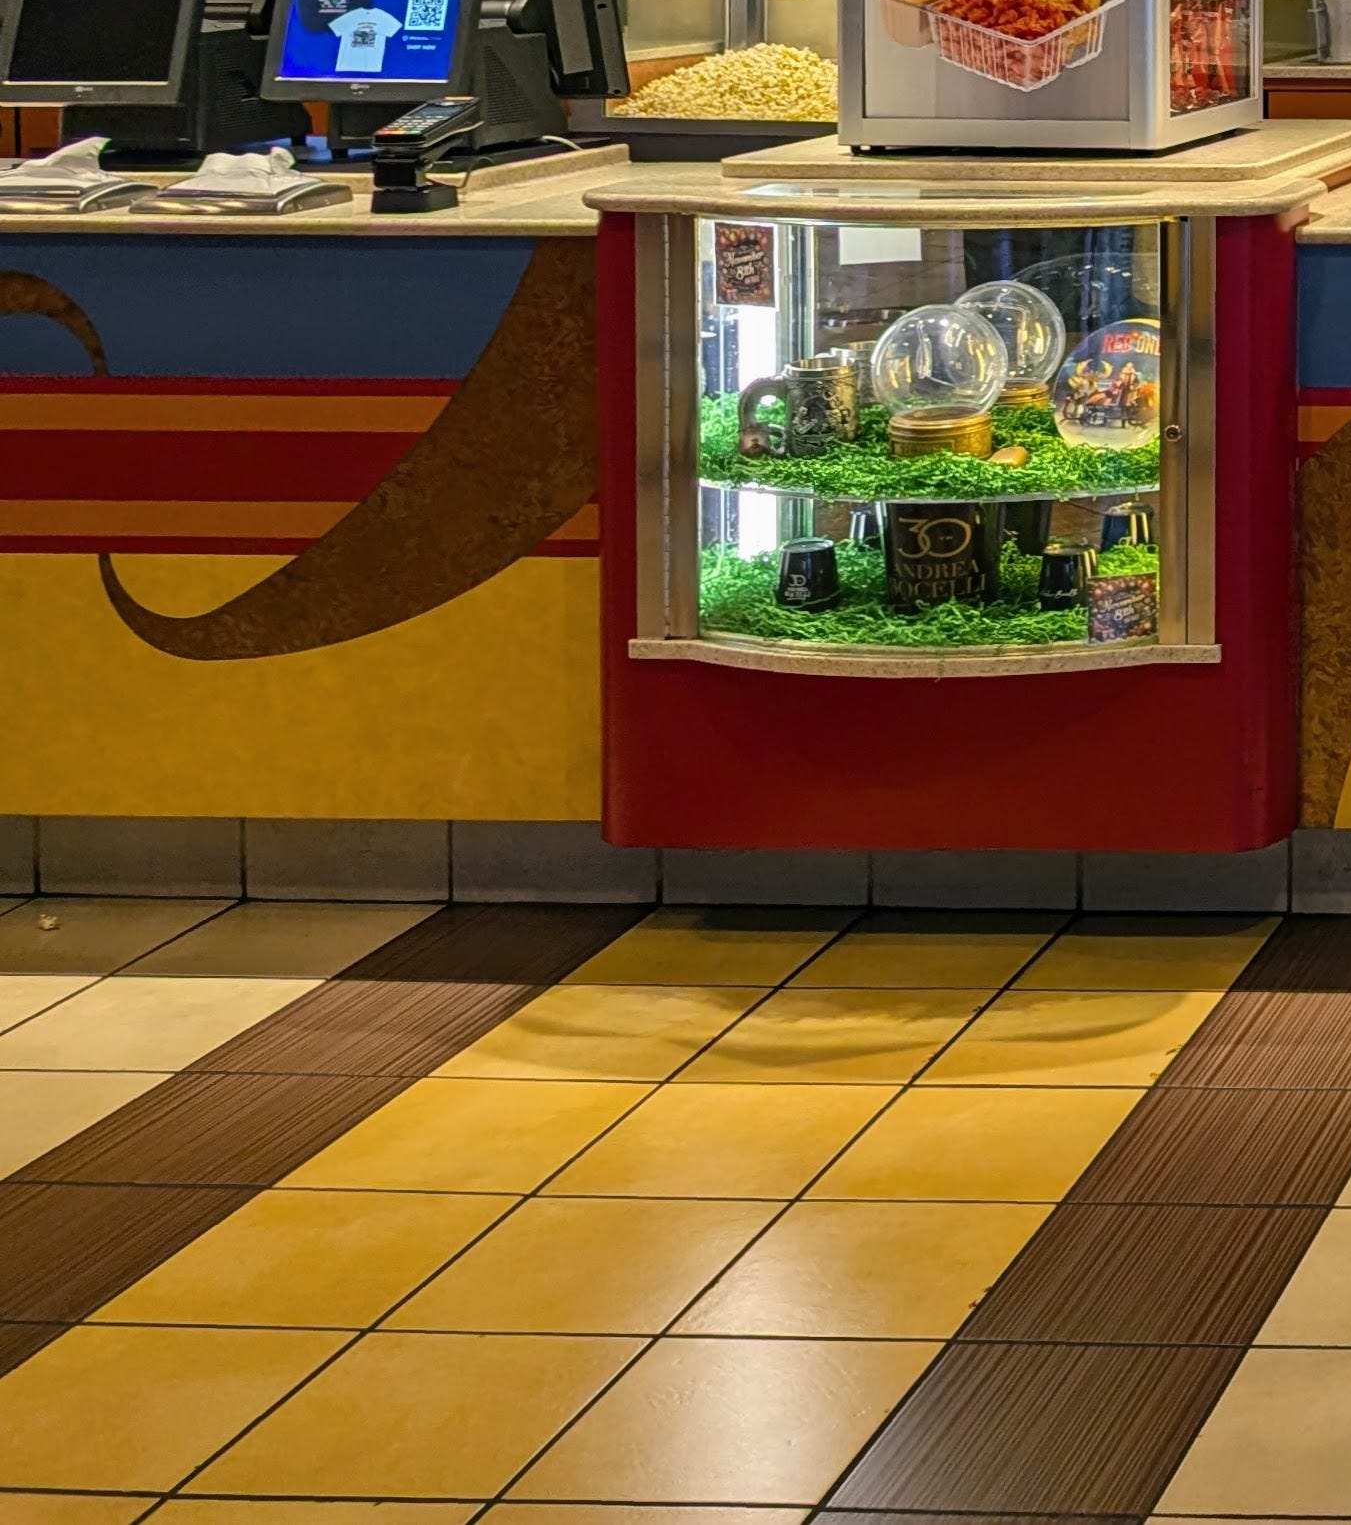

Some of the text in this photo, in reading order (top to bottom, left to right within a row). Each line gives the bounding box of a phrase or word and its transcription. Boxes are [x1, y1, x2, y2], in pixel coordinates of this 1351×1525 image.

[736, 262, 755, 280] 8th
[1103, 333, 1135, 352] RED
[898, 518, 973, 559] 30
